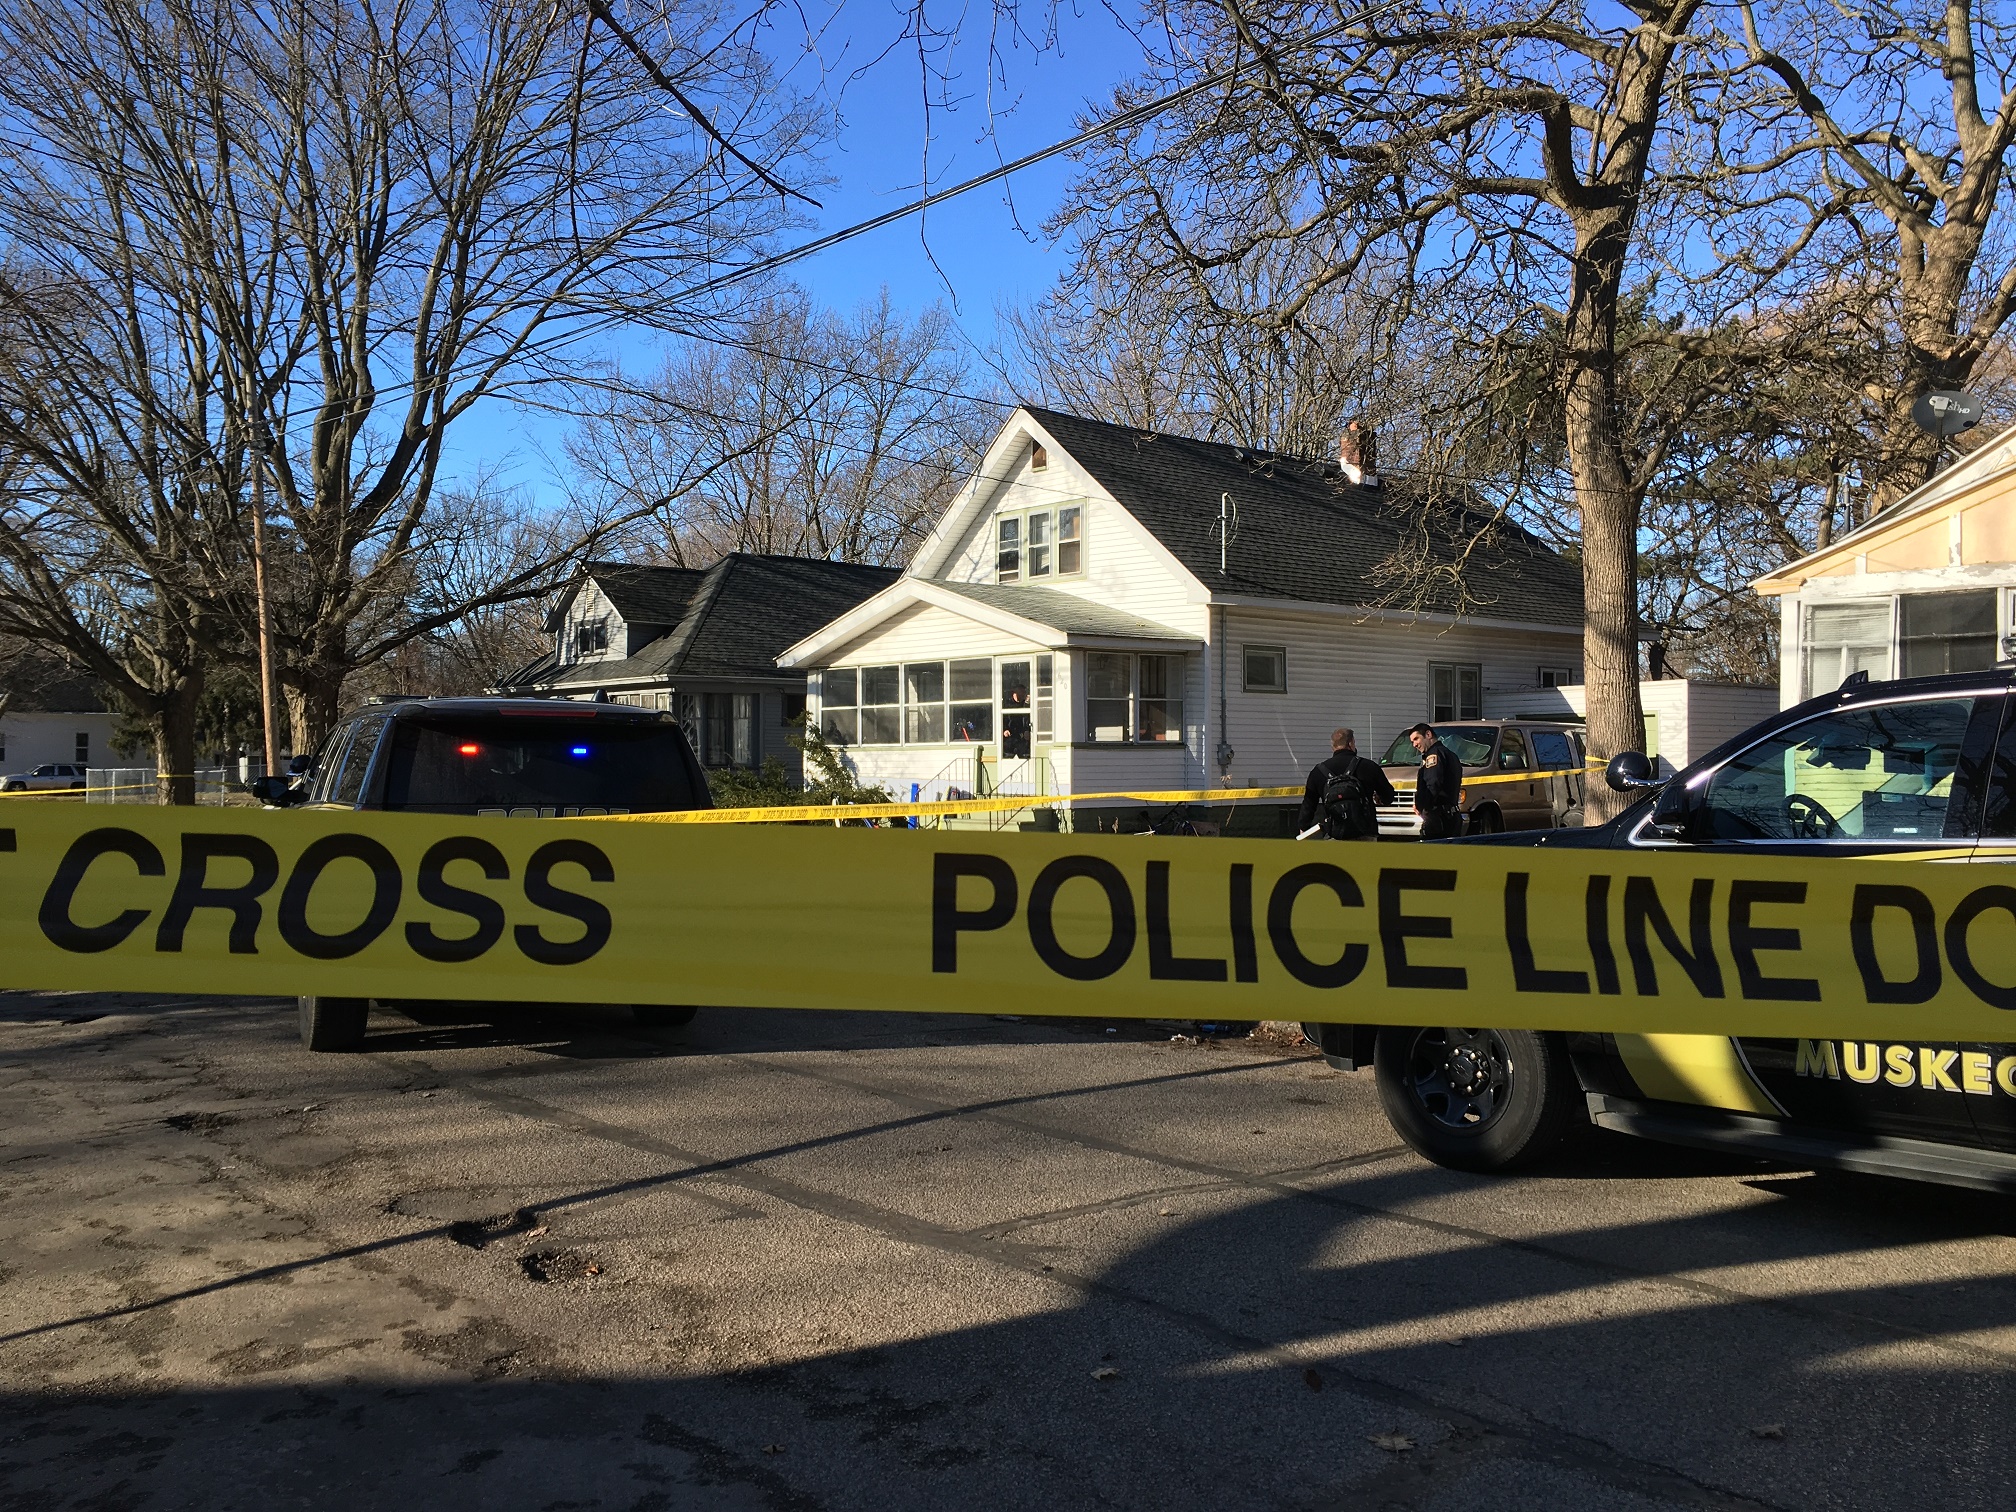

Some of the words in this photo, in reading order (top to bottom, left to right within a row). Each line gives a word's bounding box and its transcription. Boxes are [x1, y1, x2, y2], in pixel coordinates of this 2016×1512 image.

[38, 827, 615, 965] CROSS
[931, 852, 1469, 991] POLICE
[1504, 872, 1822, 1002] LINE
[1850, 884, 2016, 1010] DO
